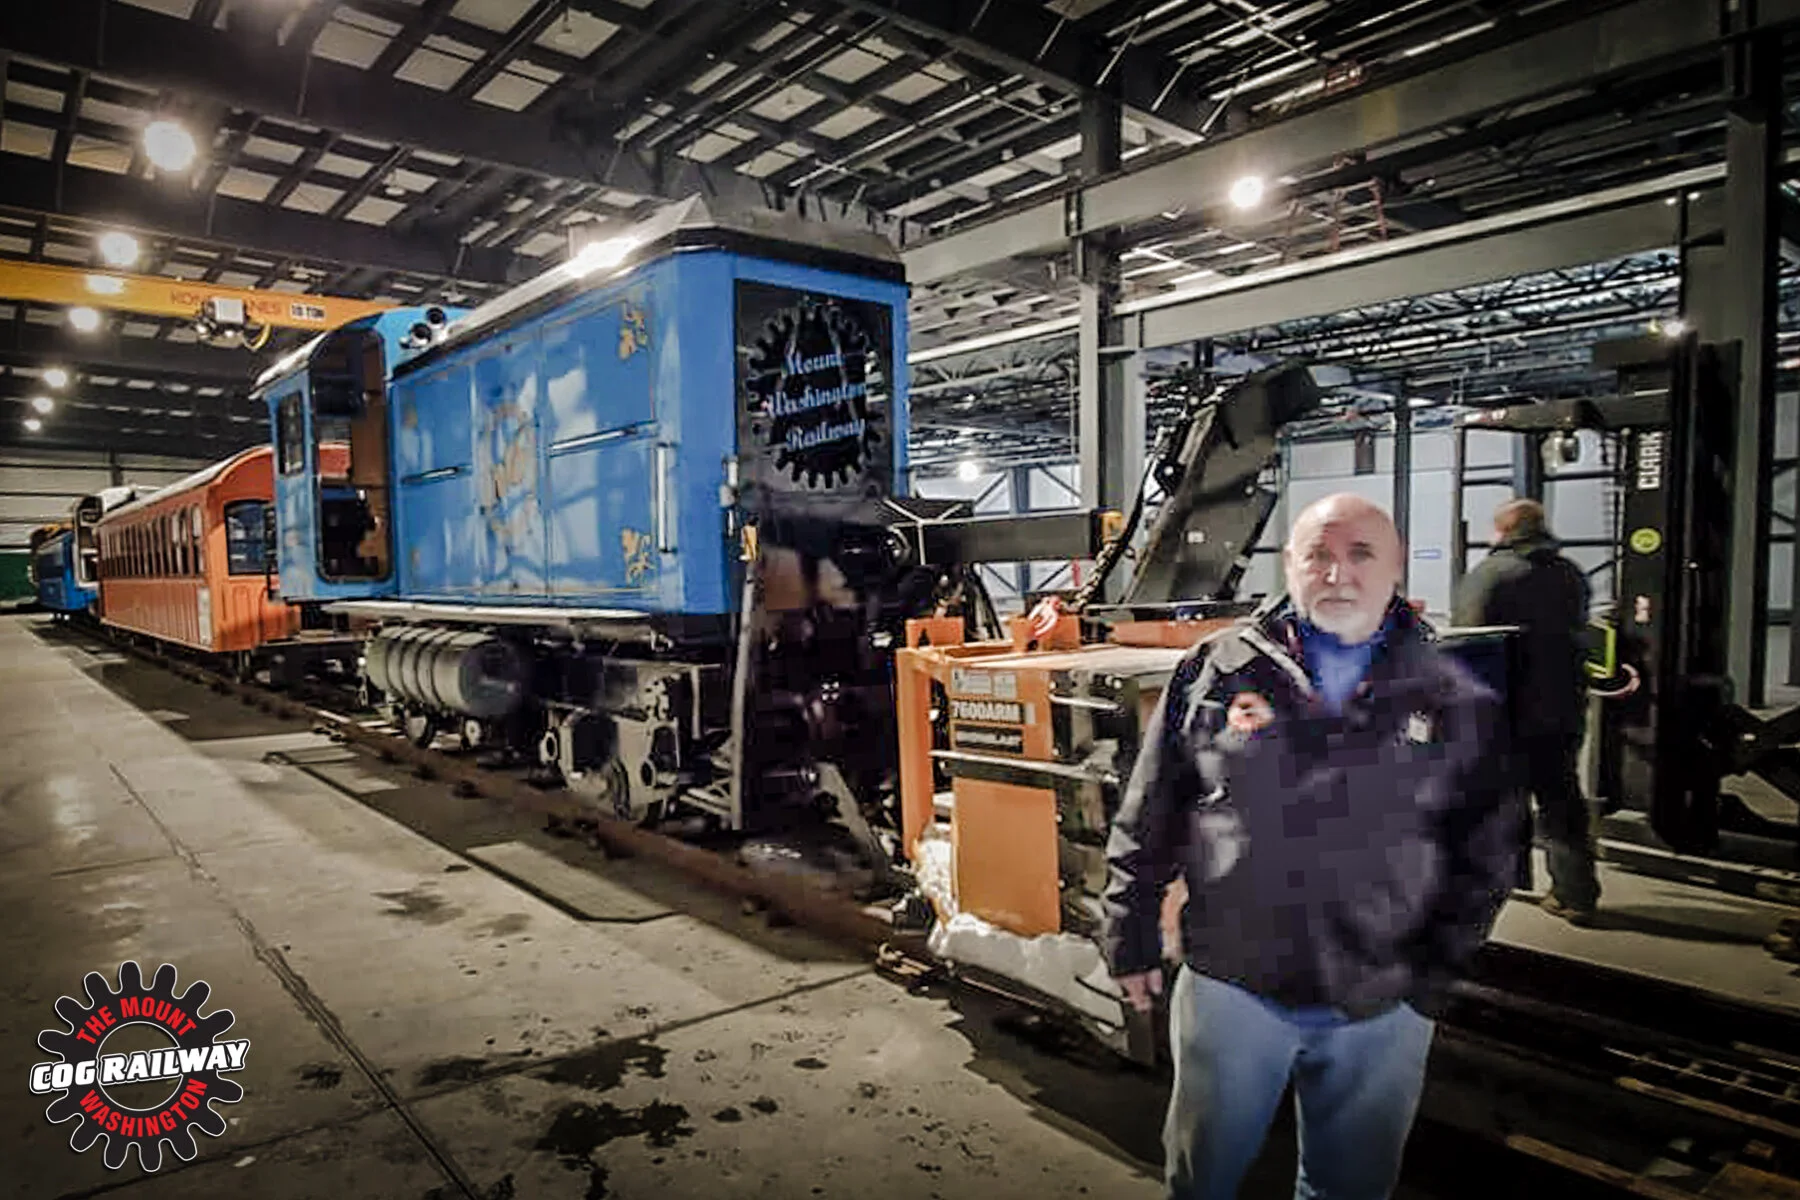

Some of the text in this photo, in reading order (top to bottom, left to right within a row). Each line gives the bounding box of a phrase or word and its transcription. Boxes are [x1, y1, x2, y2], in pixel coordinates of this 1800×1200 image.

[765, 381, 867, 417] Washington
[786, 418, 865, 451] Railway
[1637, 430, 1664, 490] CLARK
